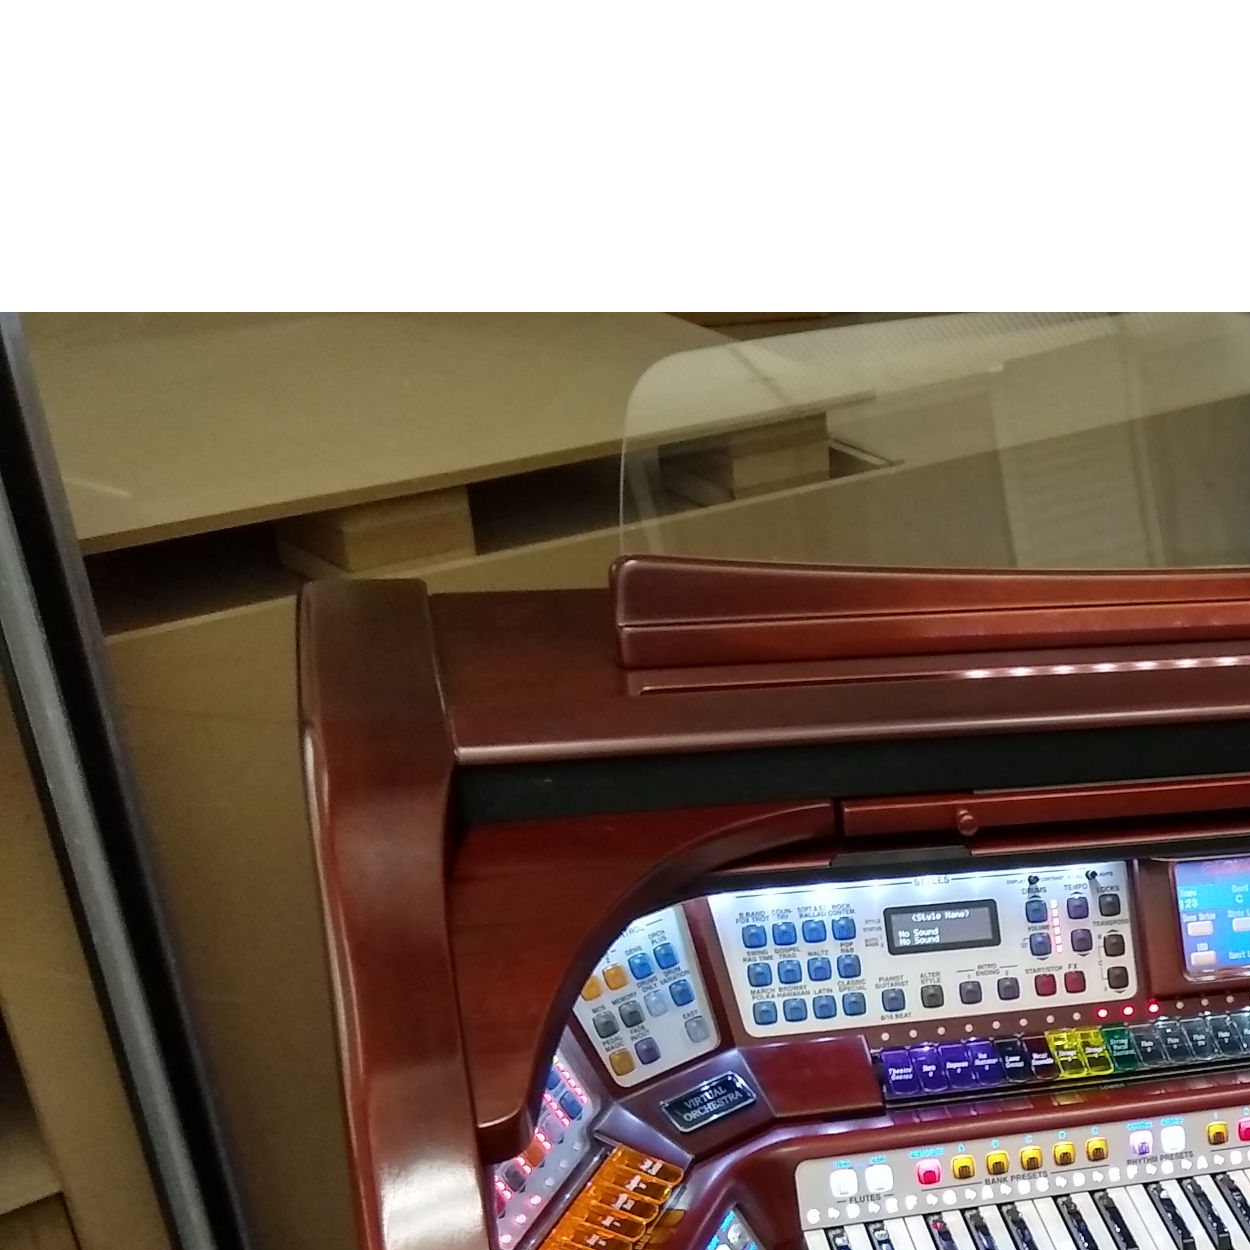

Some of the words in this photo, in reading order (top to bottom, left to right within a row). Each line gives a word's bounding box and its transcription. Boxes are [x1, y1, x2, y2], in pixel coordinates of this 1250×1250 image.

[1022, 886, 1048, 894] DRUMS
[1064, 883, 1088, 891] TEMPO
[1097, 885, 1120, 893] LOCKS
[1180, 898, 1198, 908] 123
[1235, 894, 1244, 904] C
[898, 930, 910, 938] No
[913, 927, 940, 936] Sound
[900, 938, 911, 946] No
[914, 935, 940, 944] Sound
[808, 950, 829, 958] WALTZ
[1025, 966, 1063, 974] START/STOP
[838, 984, 866, 992] SPECIAL
[875, 980, 908, 989] GUITARIST
[750, 988, 776, 996] MARCH
[612, 991, 637, 1006] MEMORY
[683, 1009, 698, 1020] EASY
[895, 1012, 912, 1020] BEAT
[602, 1036, 623, 1046] PEDAL
[684, 1085, 727, 1109] VIRTUAL
[683, 1089, 743, 1122] ORCHESTRA
[1126, 1156, 1158, 1166] RHYTHM
[1160, 1150, 1194, 1162] PRESETS
[985, 1174, 1008, 1186] BANK
[1010, 1171, 1048, 1183] PRESETS
[849, 1194, 882, 1204] FLUTES
